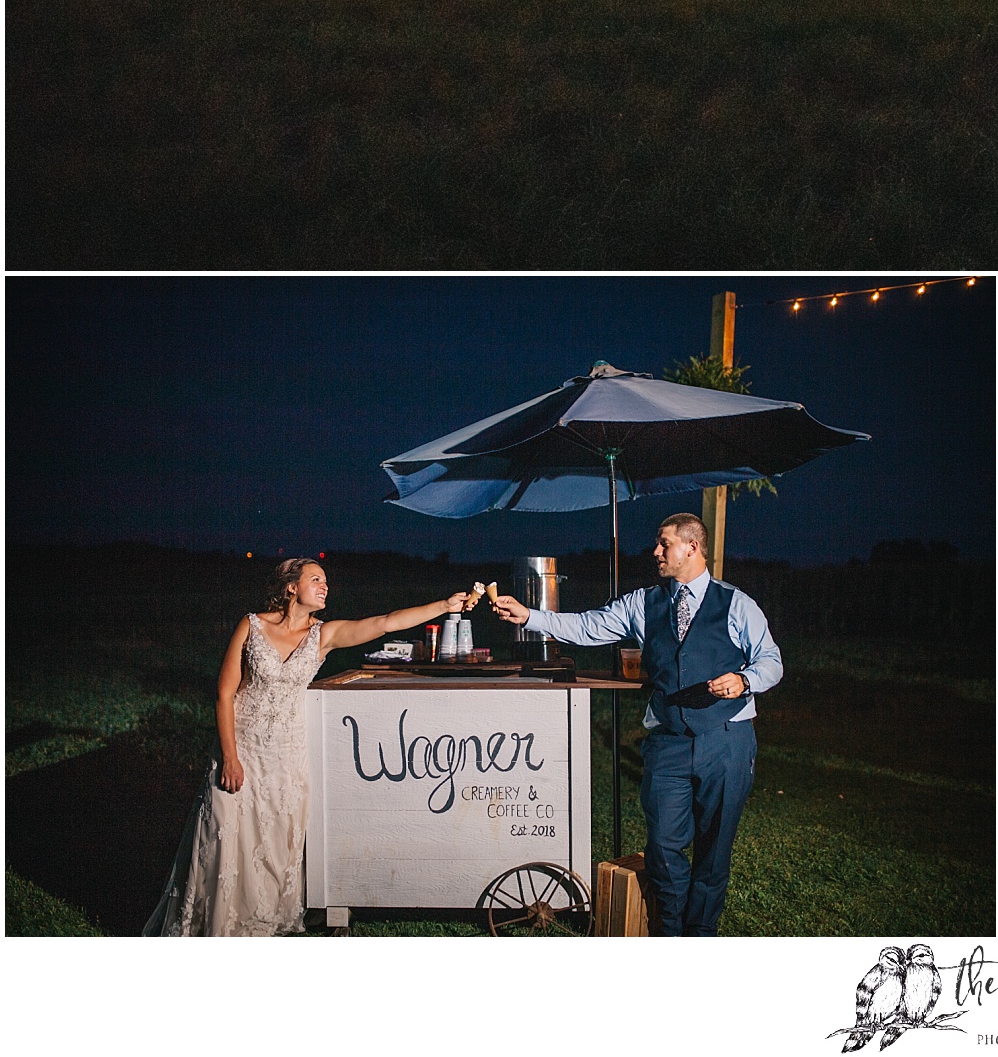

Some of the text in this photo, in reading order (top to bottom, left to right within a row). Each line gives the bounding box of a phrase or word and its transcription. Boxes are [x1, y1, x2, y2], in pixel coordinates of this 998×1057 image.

[342, 708, 545, 814] Wagner
[461, 784, 539, 802] CREAMERY &
[487, 803, 555, 819] COFFEE CO
